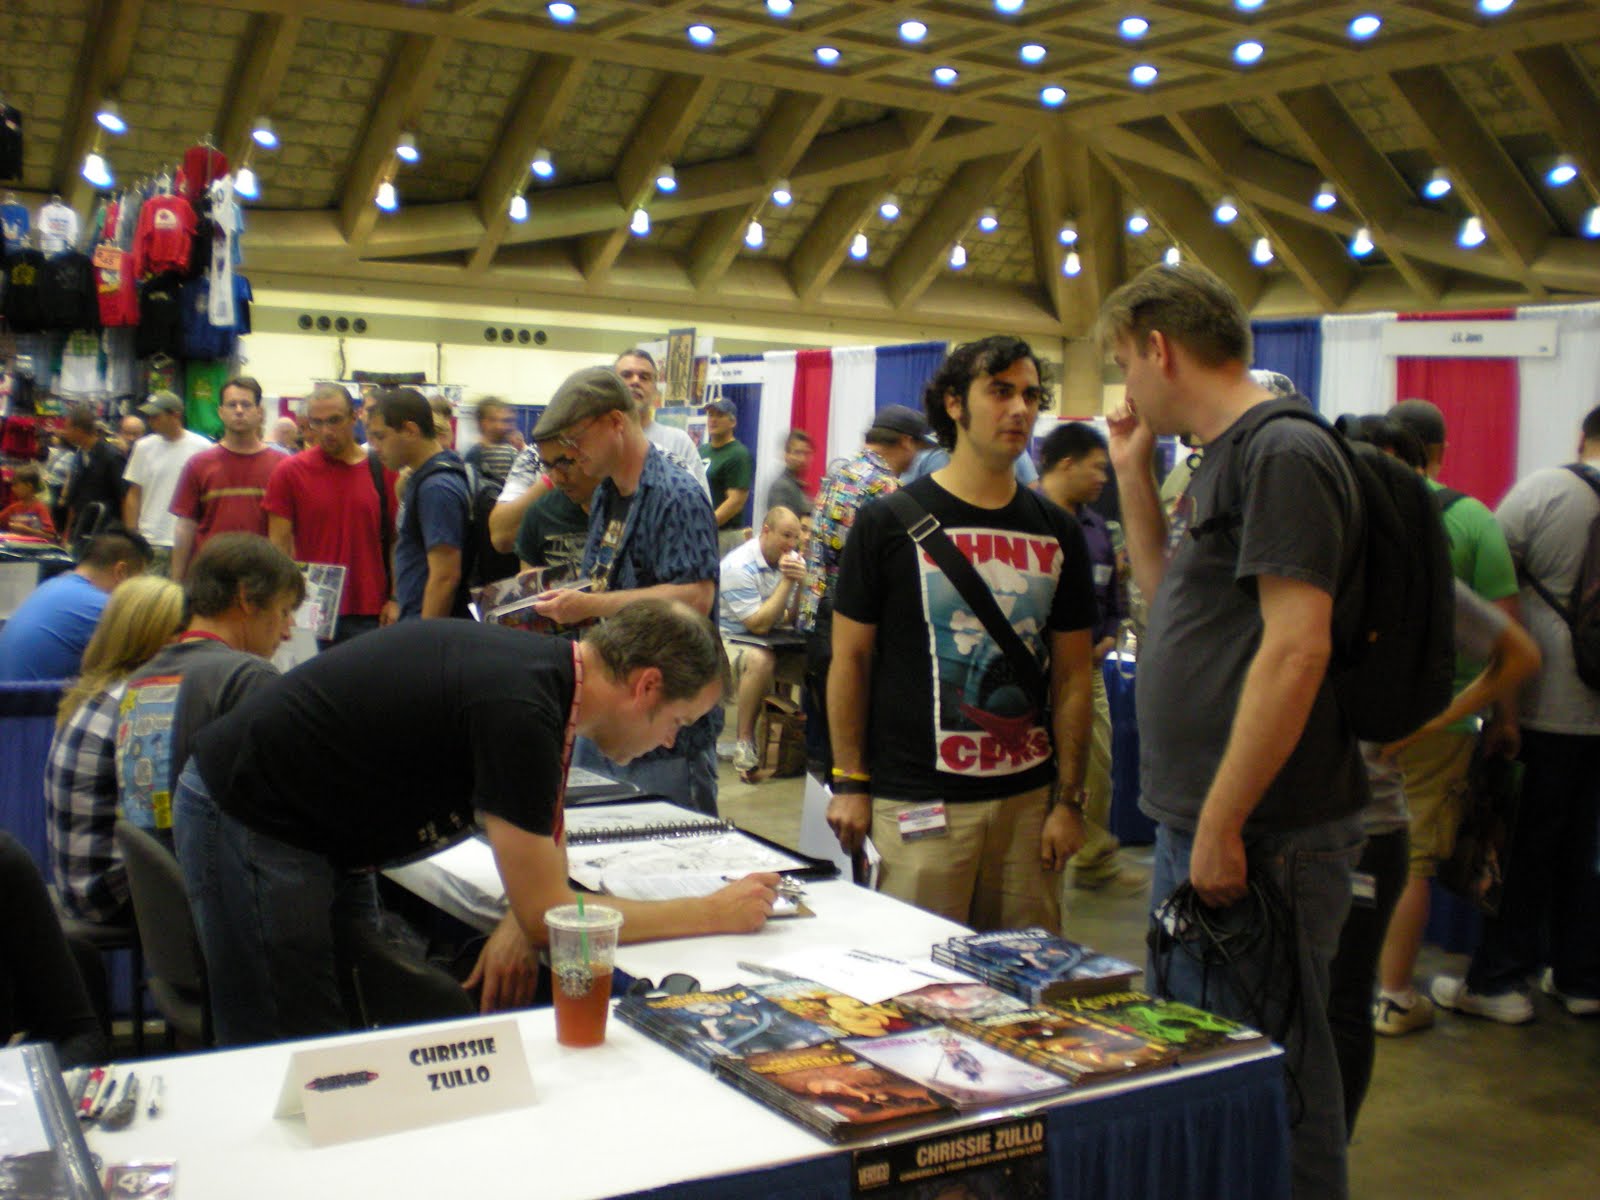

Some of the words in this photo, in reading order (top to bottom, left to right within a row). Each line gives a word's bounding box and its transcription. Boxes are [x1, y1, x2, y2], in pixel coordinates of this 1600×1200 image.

[409, 1037, 497, 1067] CHRISSIE
[427, 1065, 491, 1092] ZULLO
[916, 1132, 991, 1168] CHRISSIE
[995, 1121, 1044, 1151] ZULLO
